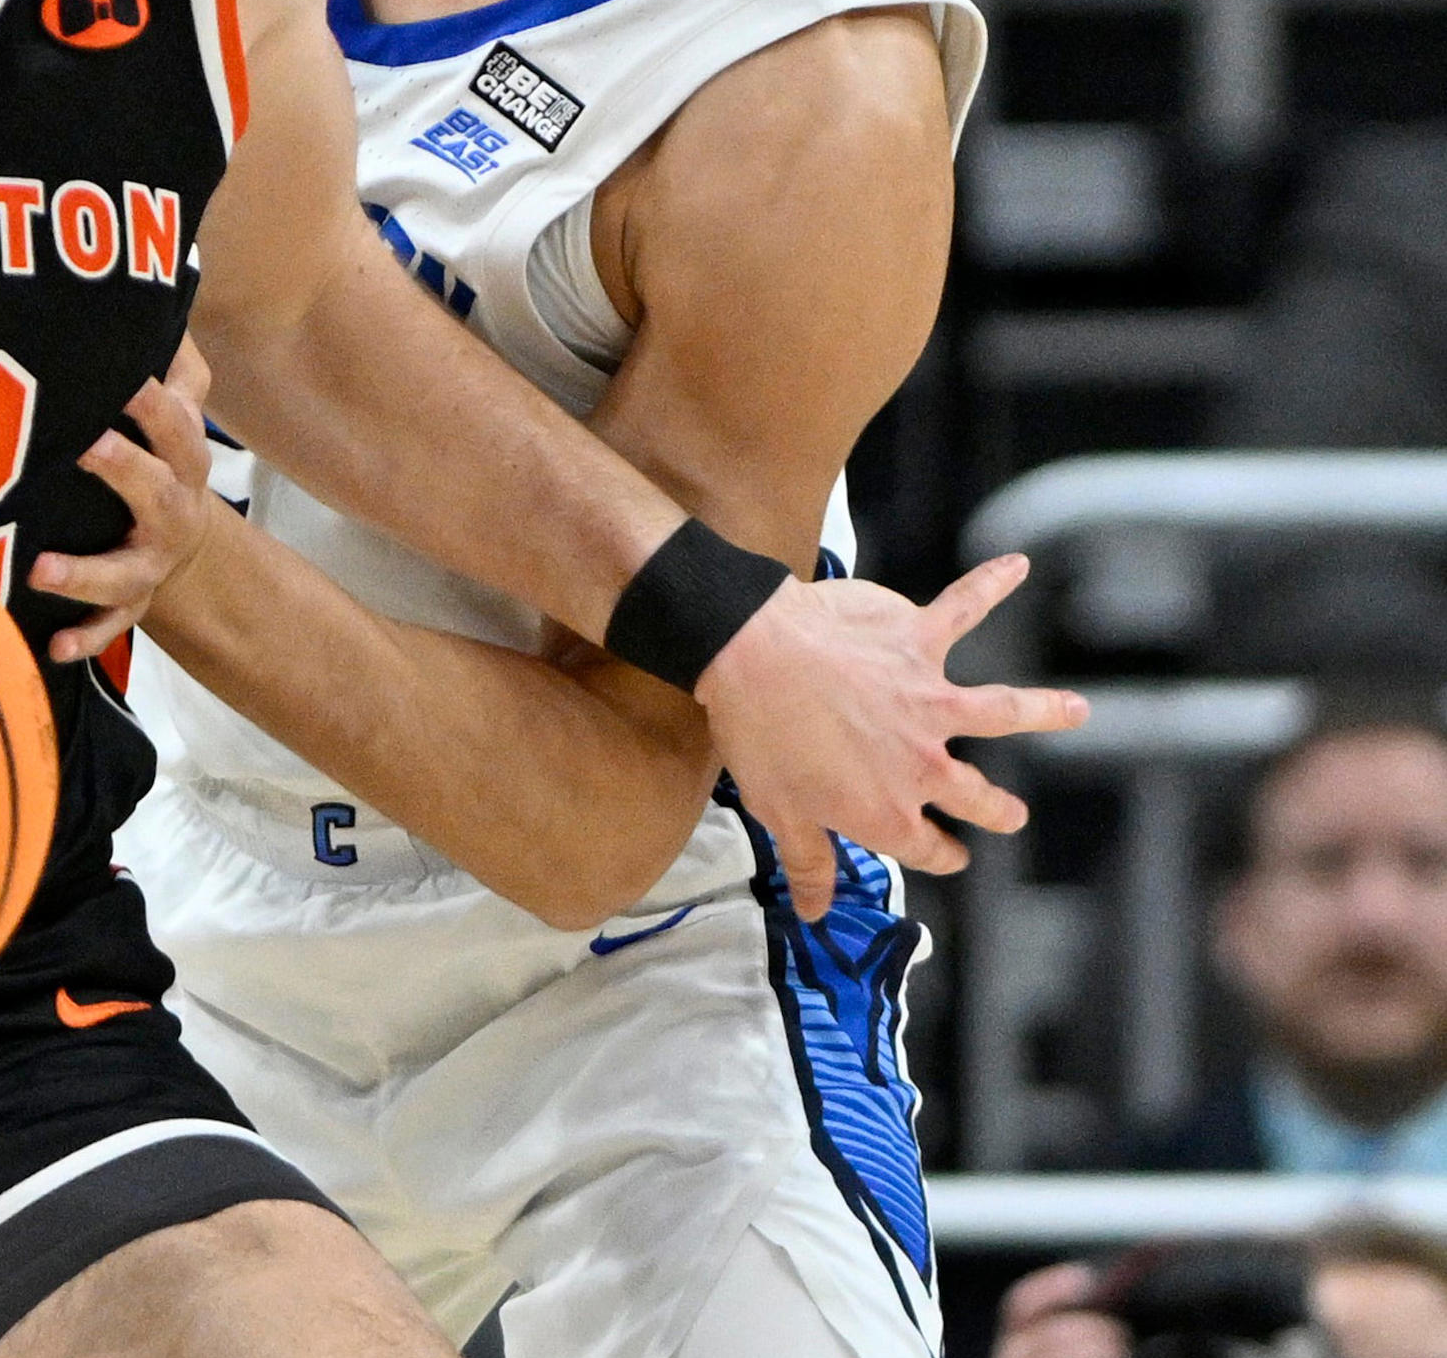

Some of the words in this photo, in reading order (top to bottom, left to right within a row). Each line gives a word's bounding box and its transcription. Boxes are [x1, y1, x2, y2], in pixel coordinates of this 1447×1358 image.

[476, 73, 563, 143] CHANGE
[486, 51, 560, 113] #BE
[423, 122, 500, 175] EAST
[443, 108, 509, 153] BIG
[310, 802, 358, 867] C
